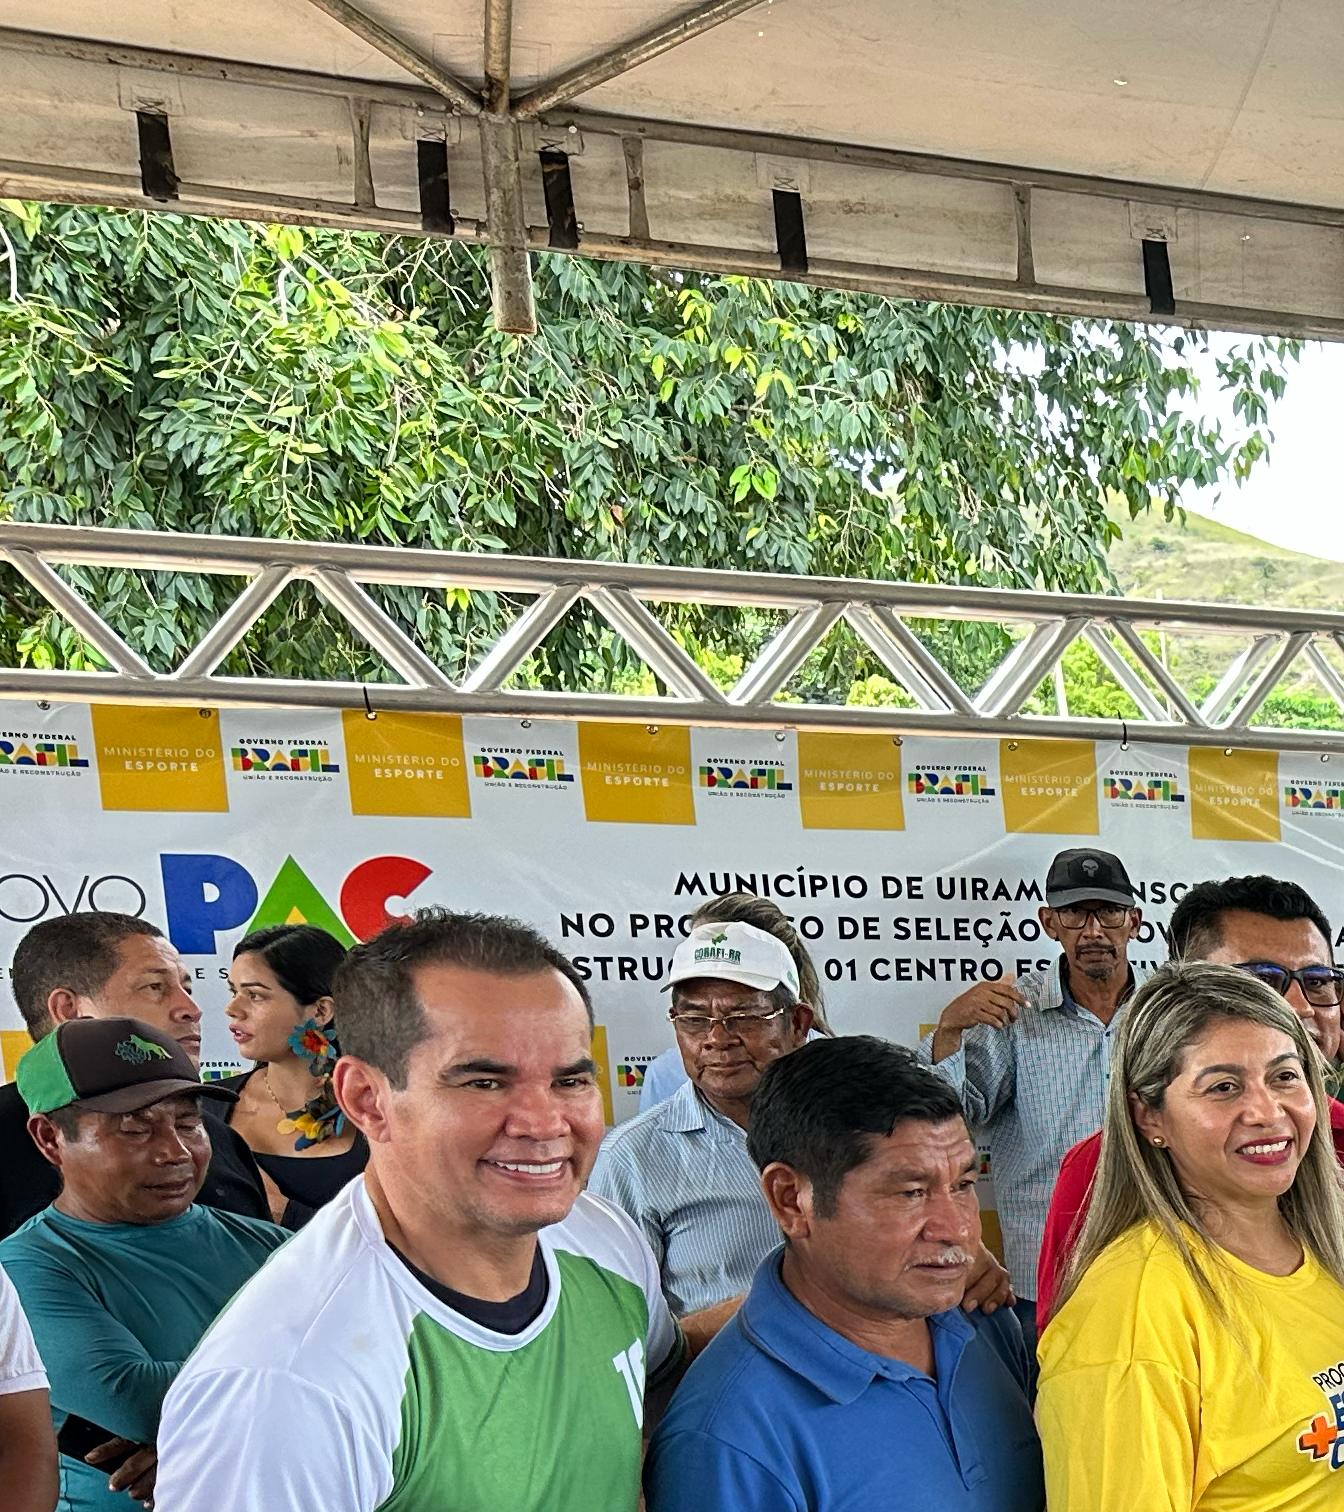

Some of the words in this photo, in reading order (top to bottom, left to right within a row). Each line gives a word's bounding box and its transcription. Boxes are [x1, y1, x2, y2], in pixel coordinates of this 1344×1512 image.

[0, 740, 89, 767] RASIL
[195, 748, 215, 758] DO
[231, 747, 340, 773] BRASIL
[441, 757, 460, 767] DO
[125, 761, 199, 772] ESPORTE
[374, 768, 444, 780] ESPORTE
[473, 755, 575, 782] BRASIL
[699, 766, 792, 790] BRASIL
[605, 776, 669, 787] ESPORTE
[908, 773, 995, 796] BRASIL
[1104, 778, 1185, 802] BRASIL
[674, 866, 868, 899] MUNICÍPIO
[882, 876, 922, 900] DE
[937, 877, 1046, 903] UIRAM
[0, 873, 146, 922] OVO
[160, 853, 433, 955] PAC
[561, 913, 614, 938] NO
[839, 917, 880, 940] DE
[894, 910, 1041, 948] SELEÇÃO
[825, 958, 856, 981] 01
[869, 957, 1002, 982] CENTRO
